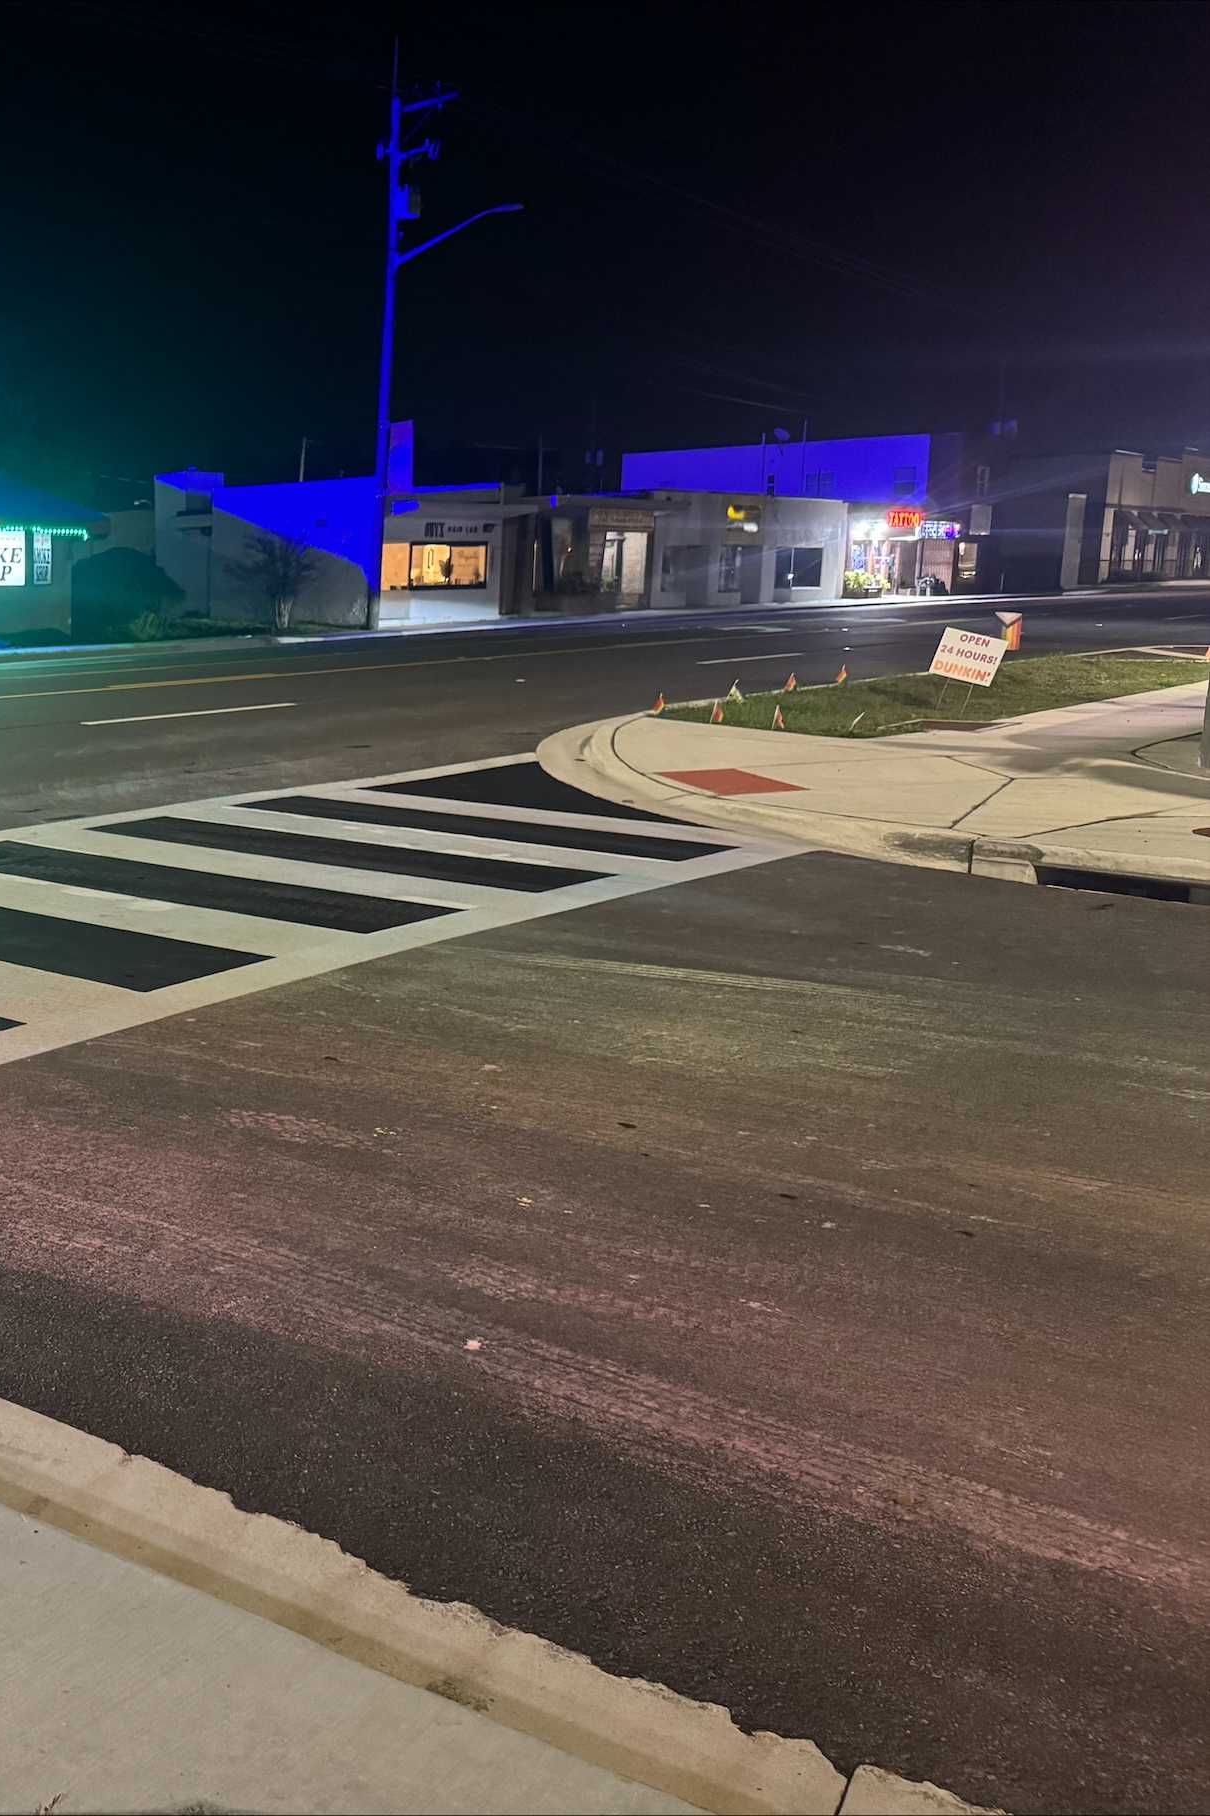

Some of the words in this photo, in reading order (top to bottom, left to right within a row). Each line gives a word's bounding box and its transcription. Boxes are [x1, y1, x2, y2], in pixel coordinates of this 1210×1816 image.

[888, 511, 921, 528] TATTOO
[960, 634, 991, 648] OPEN
[940, 645, 953, 656] 24
[955, 647, 998, 665] HOURS!
